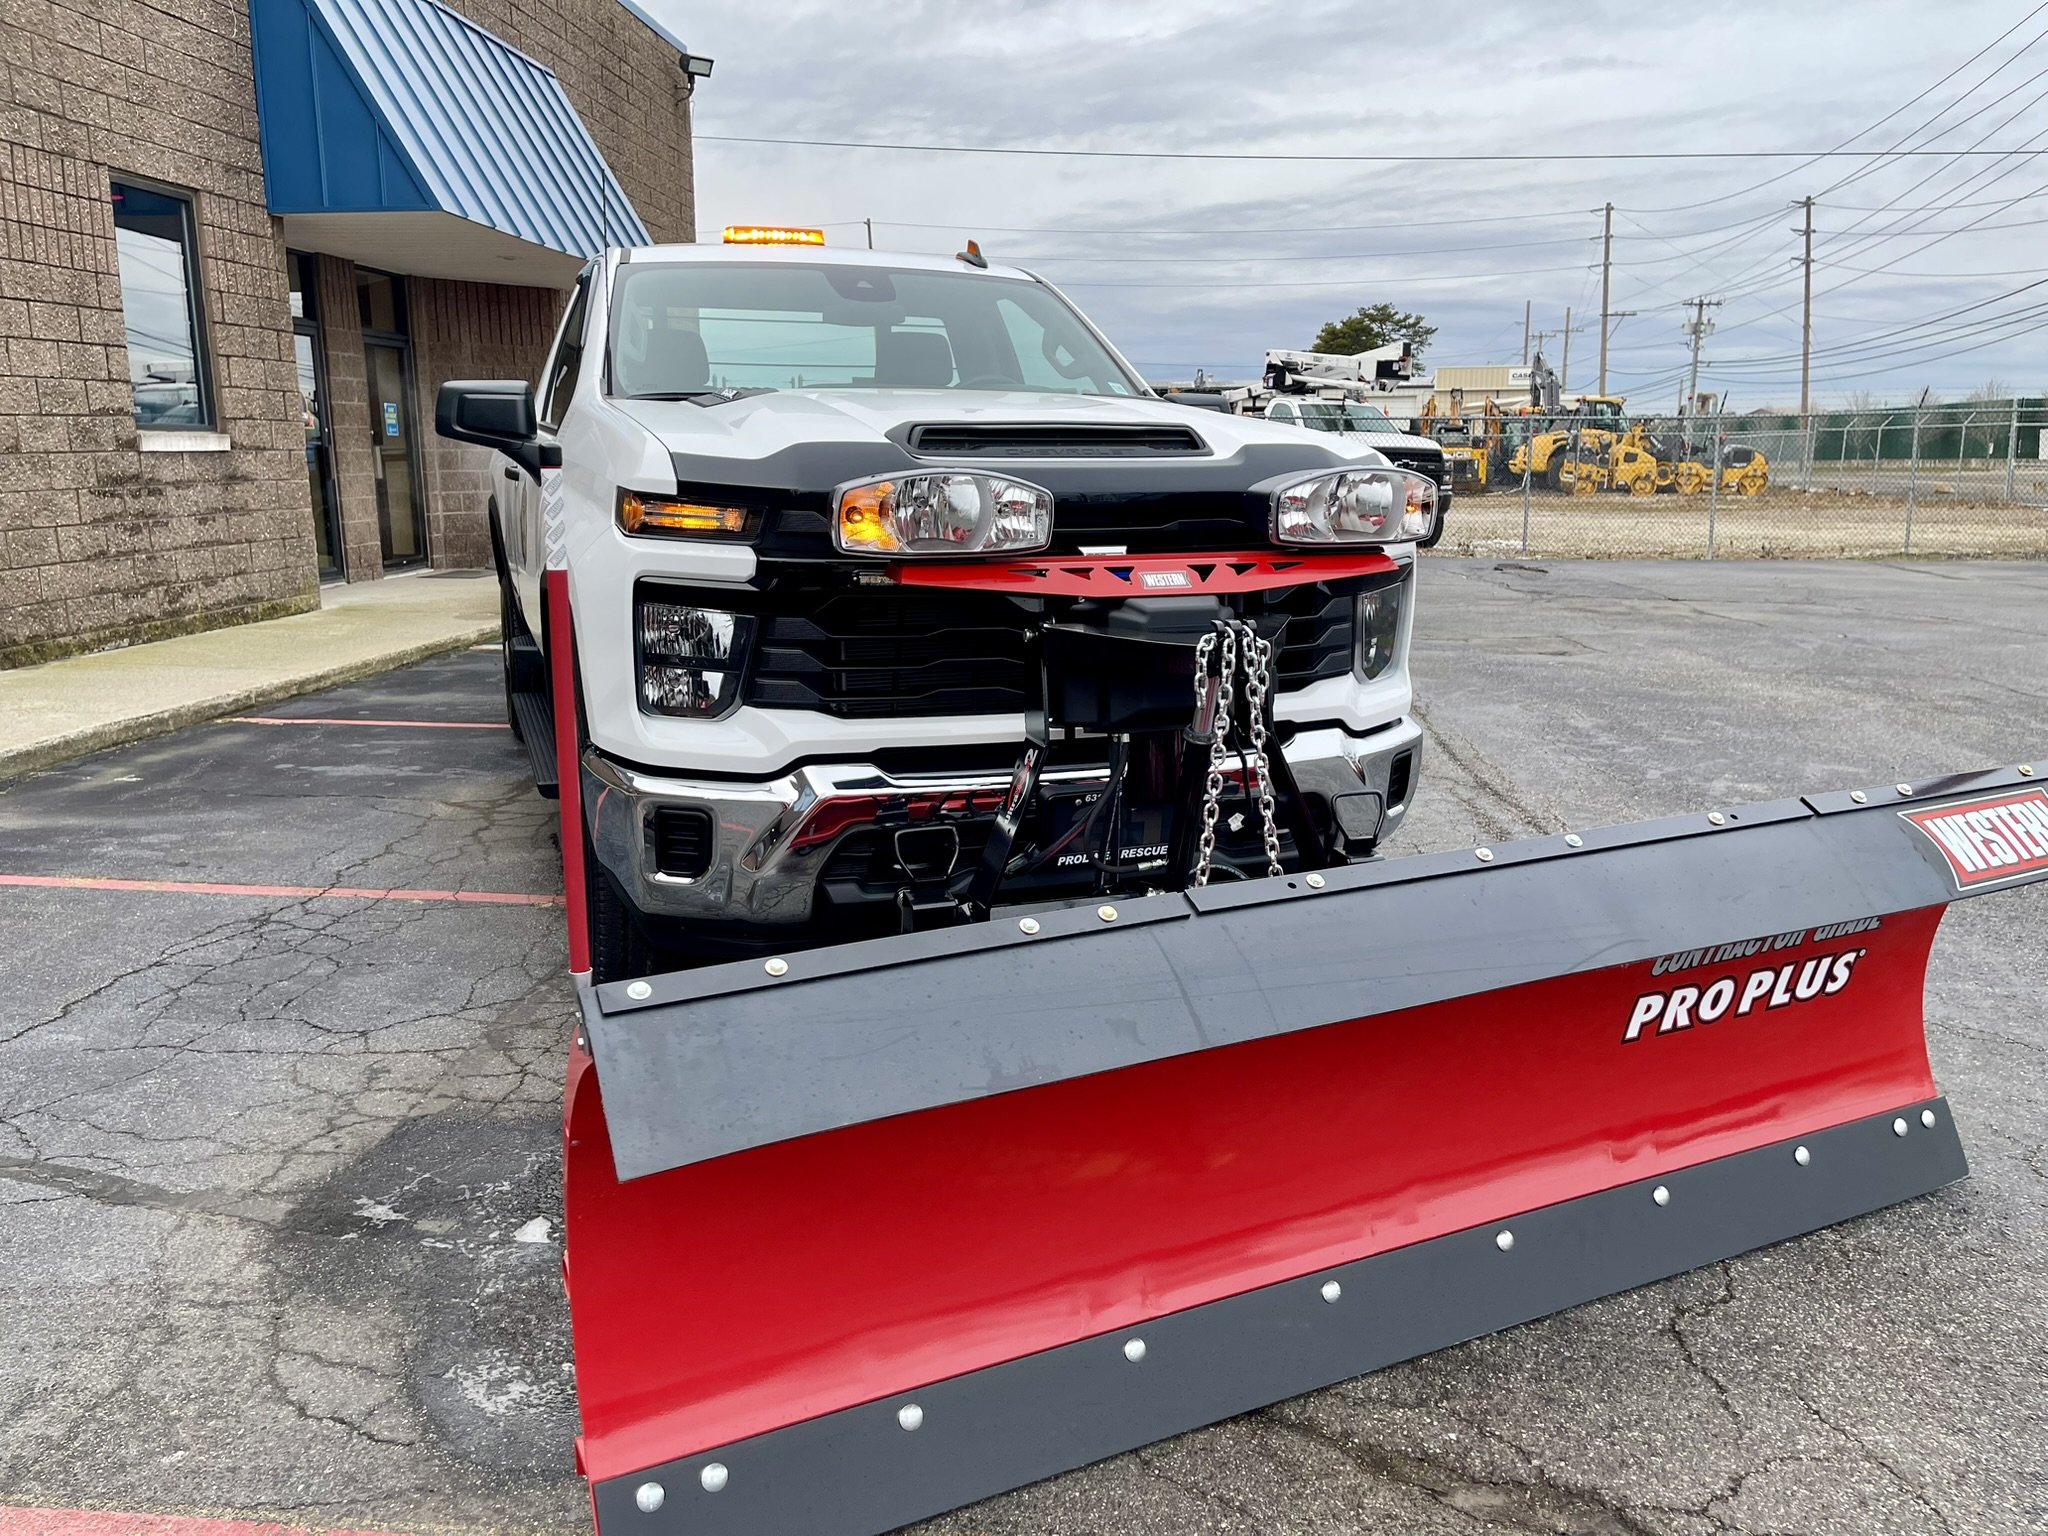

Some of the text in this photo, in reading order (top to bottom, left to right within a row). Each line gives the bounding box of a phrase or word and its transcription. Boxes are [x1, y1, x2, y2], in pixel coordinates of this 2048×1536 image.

[1005, 448, 1136, 456] CHEVROLET
[1143, 573, 1187, 587] WESTERN
[1120, 845, 1169, 859] RESCUE
[1624, 978, 1736, 1041] PRO
